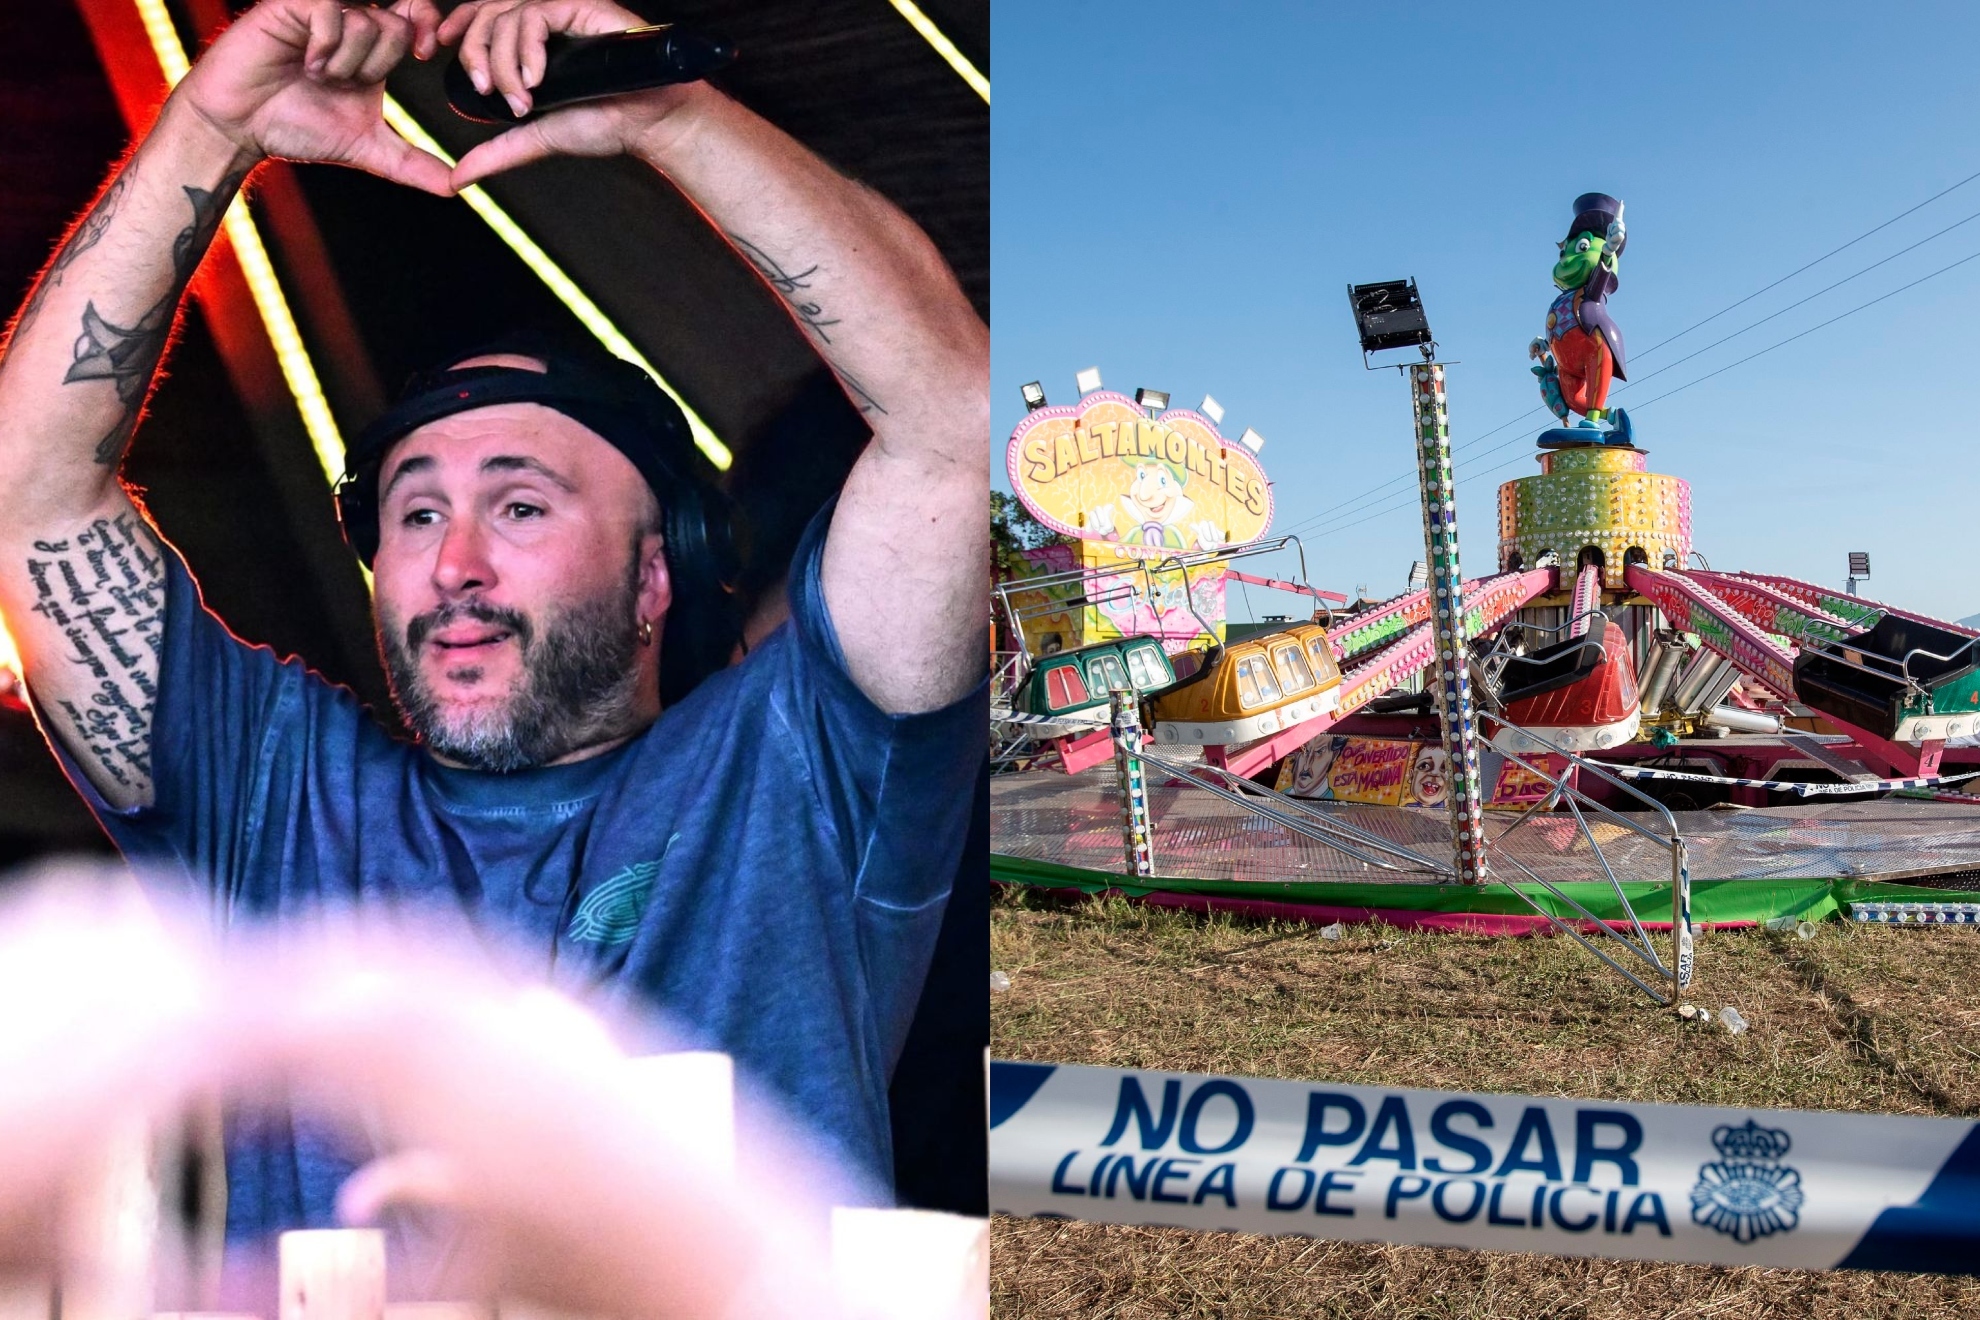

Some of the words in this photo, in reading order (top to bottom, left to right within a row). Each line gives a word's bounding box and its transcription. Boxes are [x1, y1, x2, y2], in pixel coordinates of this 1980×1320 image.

[1024, 419, 1265, 516] SALTAMONTES
[1200, 699, 1209, 713] 2
[1580, 700, 1592, 715] 3
[1970, 691, 1979, 705] 4
[1354, 745, 1409, 767] DIVERTIDO
[1923, 753, 1935, 769] 4
[1333, 770, 1359, 787] ESTA
[1356, 763, 1402, 793] MAQUINA
[1098, 1075, 1255, 1155] NO
[1295, 1091, 1644, 1187] PASAR
[1051, 1150, 1238, 1209] LINEA
[1266, 1166, 1364, 1218] DE
[1384, 1174, 1673, 1238] POLICIA
